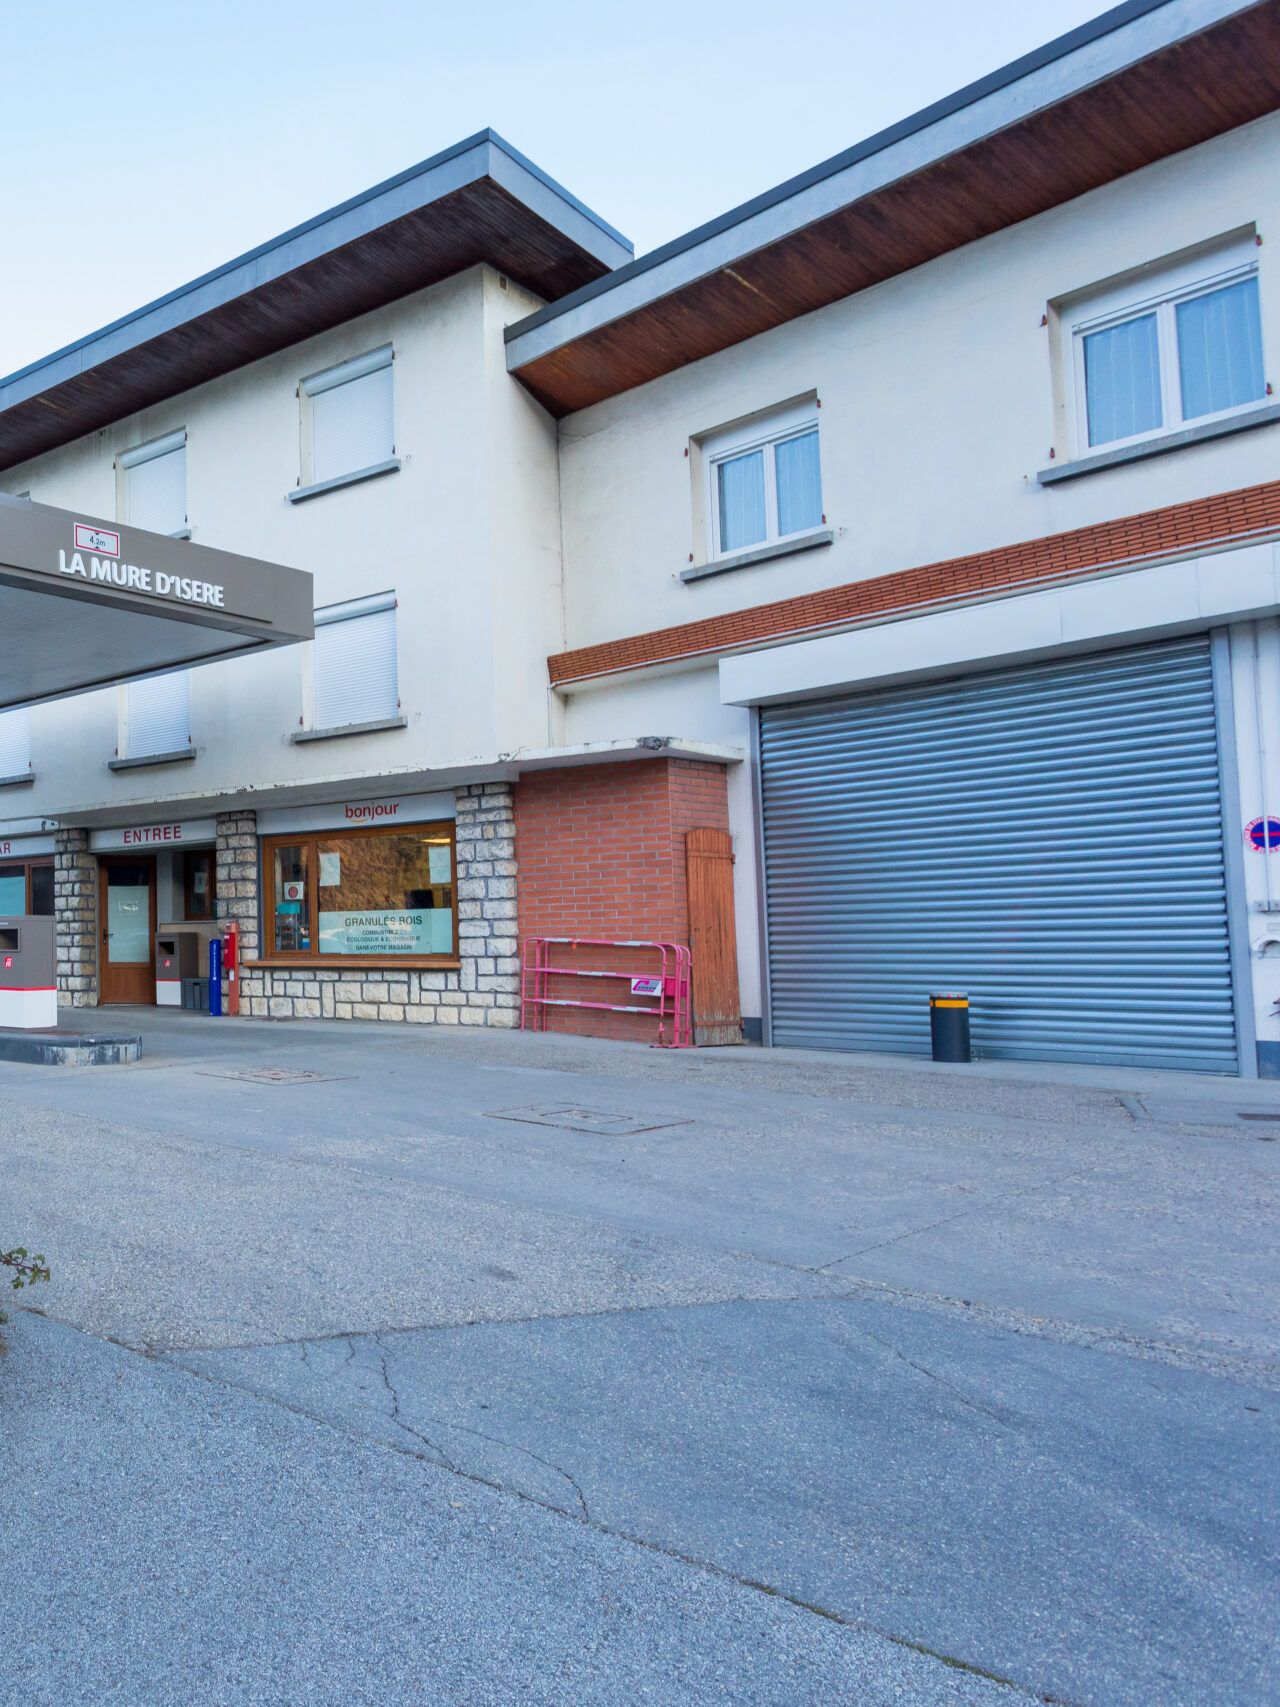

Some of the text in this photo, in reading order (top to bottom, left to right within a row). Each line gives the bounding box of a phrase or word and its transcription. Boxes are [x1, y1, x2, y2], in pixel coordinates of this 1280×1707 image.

[59, 549, 225, 607] LA MURE D'ISERE
[345, 801, 399, 820] bonjour
[123, 825, 182, 844] ENTREE
[399, 915, 423, 925] BOIS
